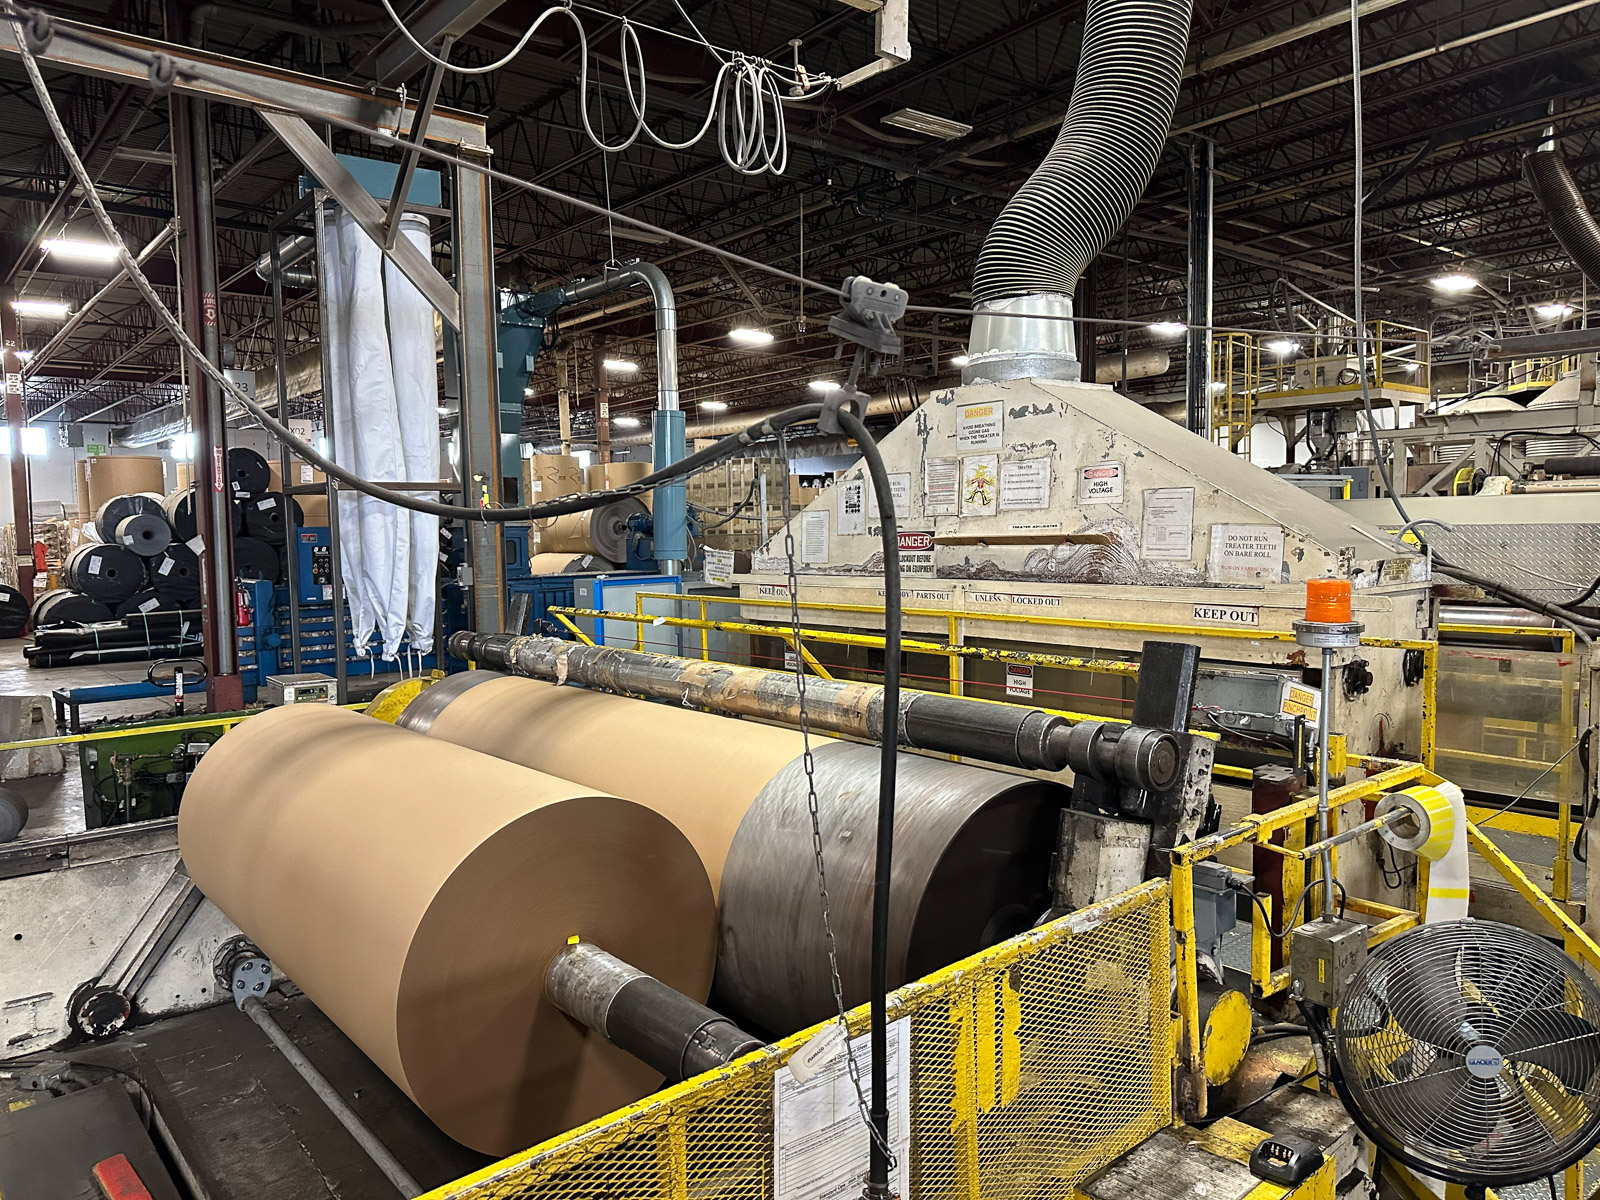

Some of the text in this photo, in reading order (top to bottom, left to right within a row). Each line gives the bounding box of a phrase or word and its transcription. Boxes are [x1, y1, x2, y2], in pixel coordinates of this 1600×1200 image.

[964, 407, 994, 418] DANGER
[290, 427, 305, 435] X02
[1088, 469, 1116, 477] DANGER
[1225, 542, 1255, 550] TREATER
[912, 564, 935, 573] EQUIPMENT
[975, 594, 1002, 602] UNLESS
[1012, 597, 1044, 605] LOCKED
[1045, 598, 1060, 606] OUT
[1193, 607, 1258, 622] KEEP OUT
[1010, 666, 1030, 675] DANGER
[1290, 687, 1314, 706] DANGER
[1283, 700, 1317, 721] PINCHPOINT
